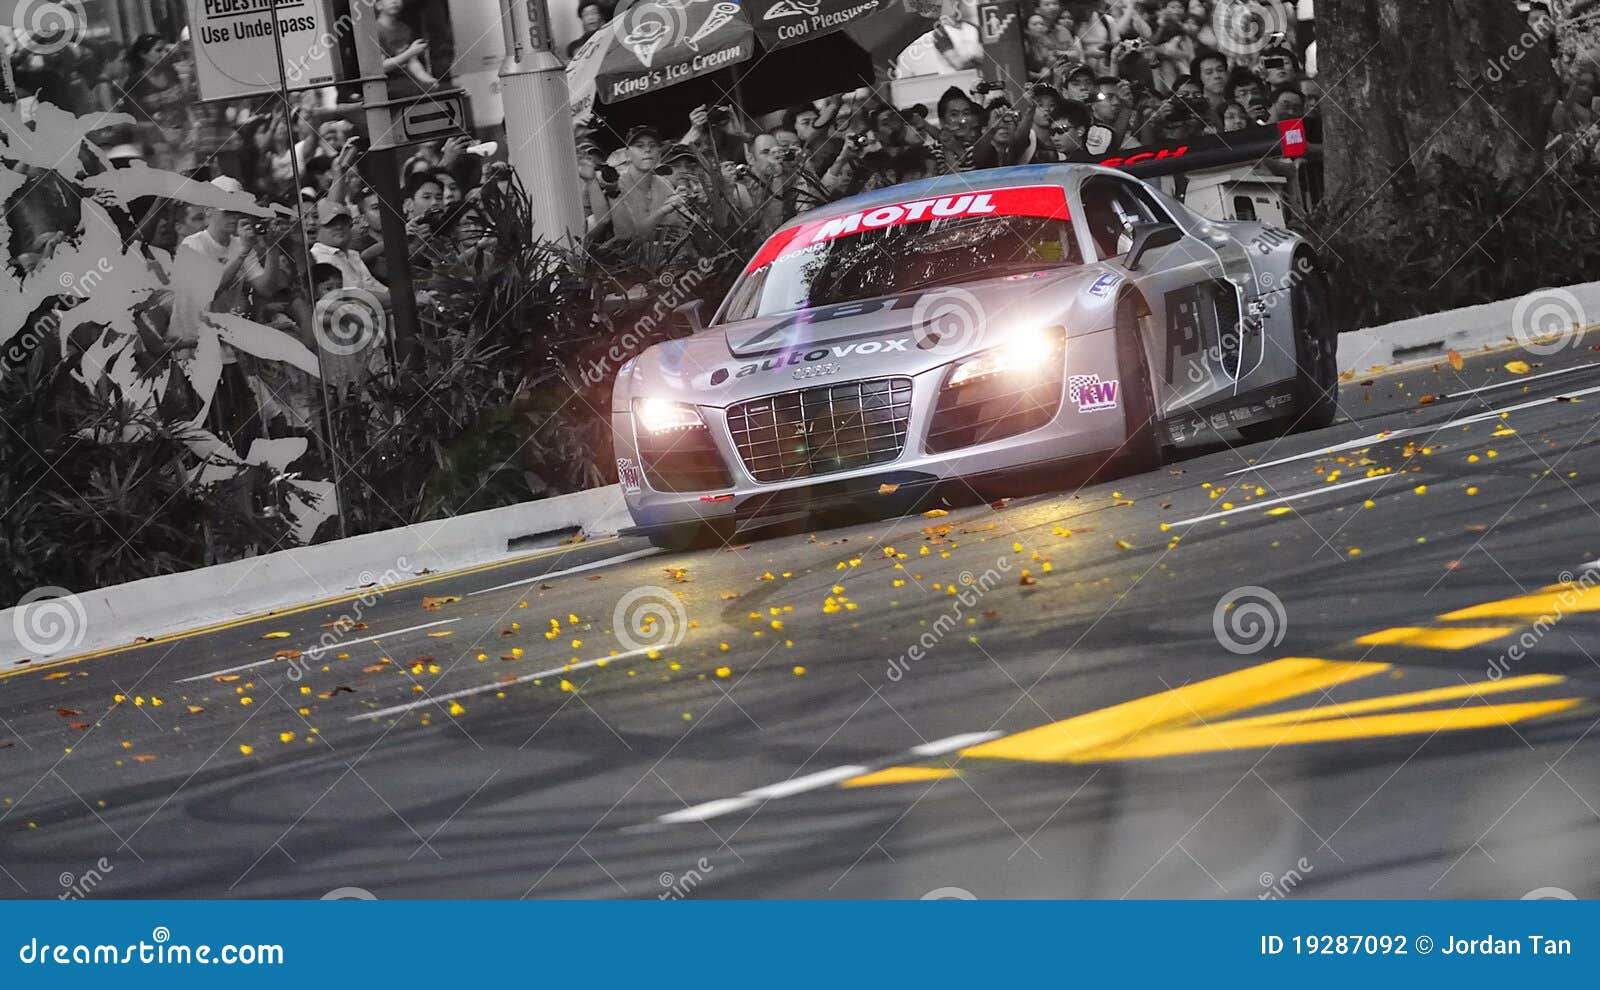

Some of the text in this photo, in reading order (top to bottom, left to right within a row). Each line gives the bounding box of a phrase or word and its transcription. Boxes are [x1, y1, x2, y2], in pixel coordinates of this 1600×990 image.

[201, 15, 316, 44] Use Undepass
[777, 0, 880, 41] Cool Pleasures
[613, 45, 741, 97] King's Ice Cream
[811, 193, 998, 243] MOTUL
[735, 338, 910, 379] autovox
[1079, 381, 1118, 406] KW
